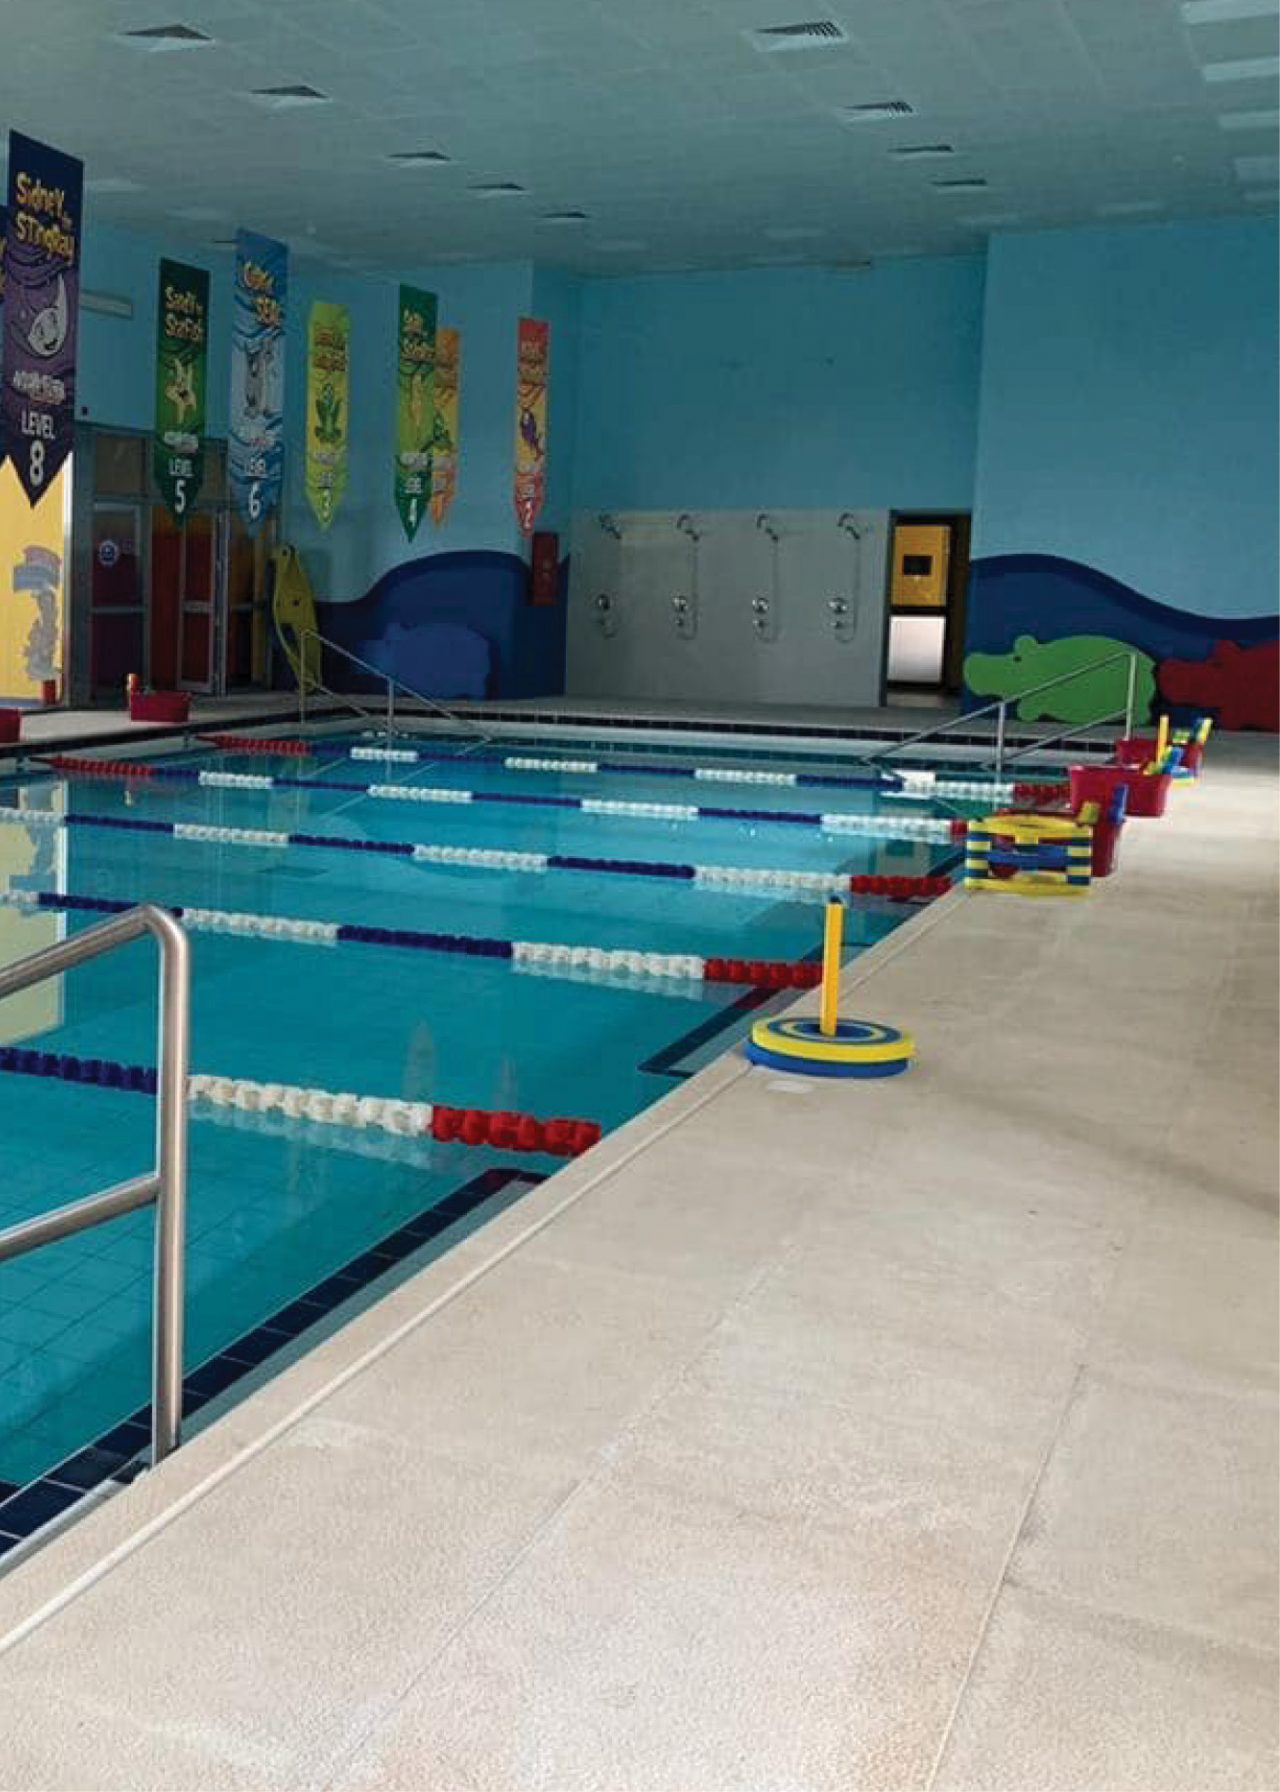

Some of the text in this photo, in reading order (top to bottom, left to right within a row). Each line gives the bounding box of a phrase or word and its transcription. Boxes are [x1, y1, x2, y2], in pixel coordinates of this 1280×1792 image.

[21, 410, 56, 440] LEVEL
[29, 440, 44, 486] 8
[174, 479, 186, 514] 5
[248, 481, 261, 519] 6
